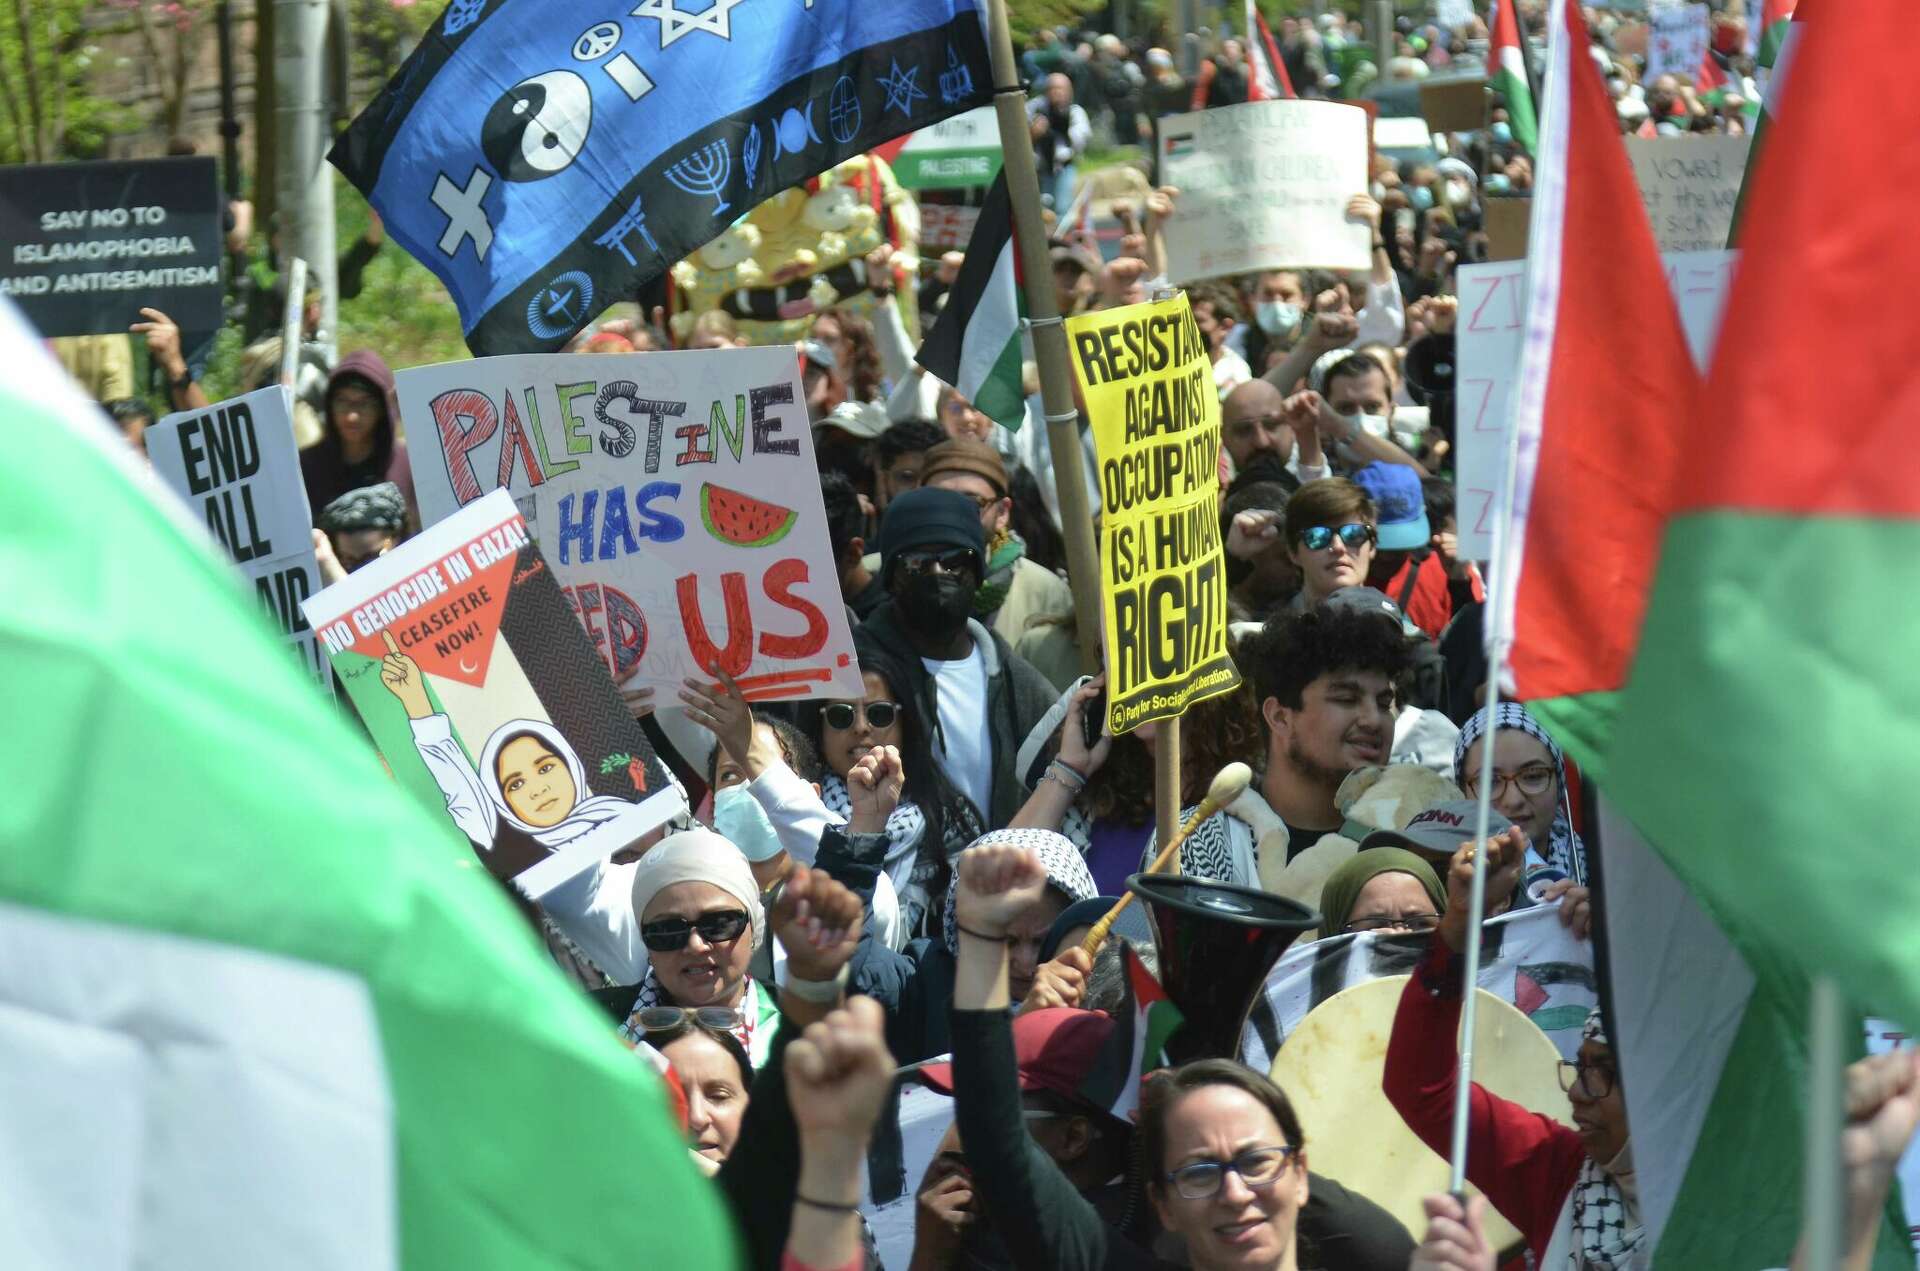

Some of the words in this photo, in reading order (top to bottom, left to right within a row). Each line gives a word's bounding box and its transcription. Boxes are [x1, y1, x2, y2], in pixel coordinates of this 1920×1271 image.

[13, 235, 196, 264] ISLAMOPHOBIA
[40, 210, 88, 231] SAY
[91, 207, 129, 228] NO
[131, 205, 167, 226] TO
[0, 275, 50, 295] AND
[52, 265, 220, 293] ANTISEMITISM
[429, 379, 801, 508] PALESTINE
[1125, 367, 1206, 445] AGAINST
[176, 401, 261, 497] END
[1103, 424, 1218, 515] OCCUPATION
[205, 483, 273, 564] ALL
[558, 480, 686, 566] HAS
[1111, 526, 1135, 586] IS
[1137, 519, 1150, 577] A
[1154, 494, 1220, 571] HUMAN
[320, 620, 356, 656] NO
[352, 565, 449, 638] GENOCIDE
[443, 551, 473, 585] IN
[467, 518, 531, 570] GAZA!
[400, 585, 493, 649] CEASEFIRE
[1113, 553, 1225, 695] RIGHT!
[434, 620, 484, 659] NOW!
[1126, 704, 1140, 721] Party
[1140, 698, 1151, 714] for
[1195, 668, 1233, 691] Liberation
